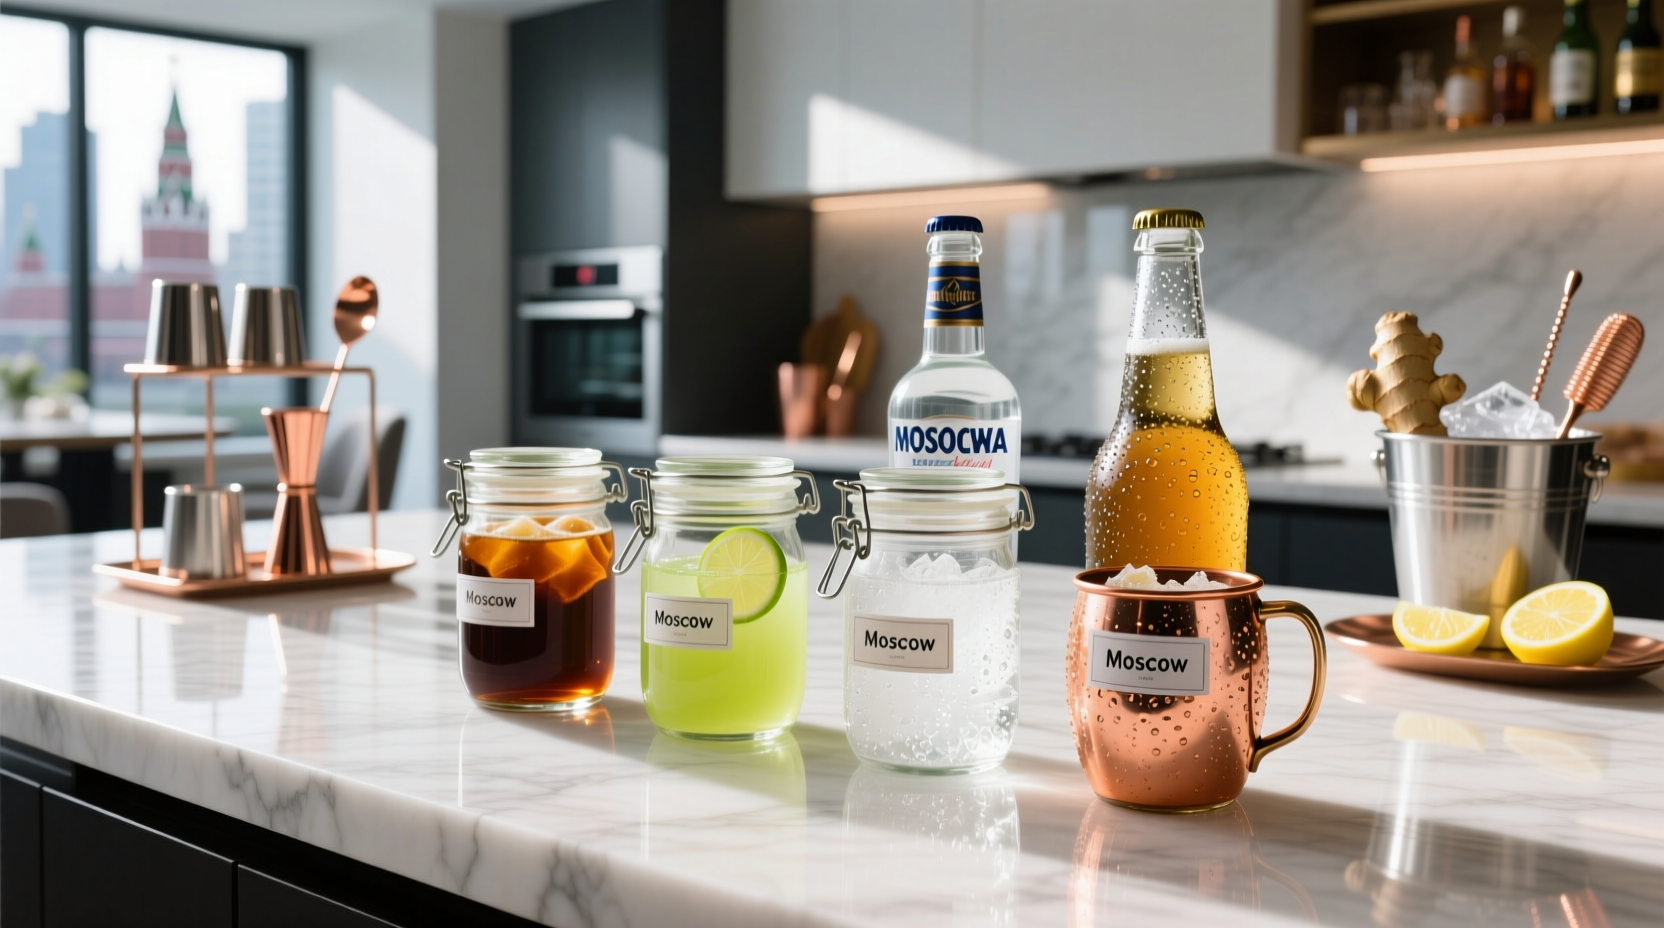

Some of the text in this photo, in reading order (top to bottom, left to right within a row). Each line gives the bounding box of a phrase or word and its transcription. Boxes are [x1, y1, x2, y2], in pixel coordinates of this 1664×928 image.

[895, 426, 1008, 454] MOSOCWA
[465, 590, 517, 608] Moscow
[655, 610, 714, 629] Moscow
[864, 629, 936, 651] Moscow
[1106, 648, 1189, 673] Moscow
